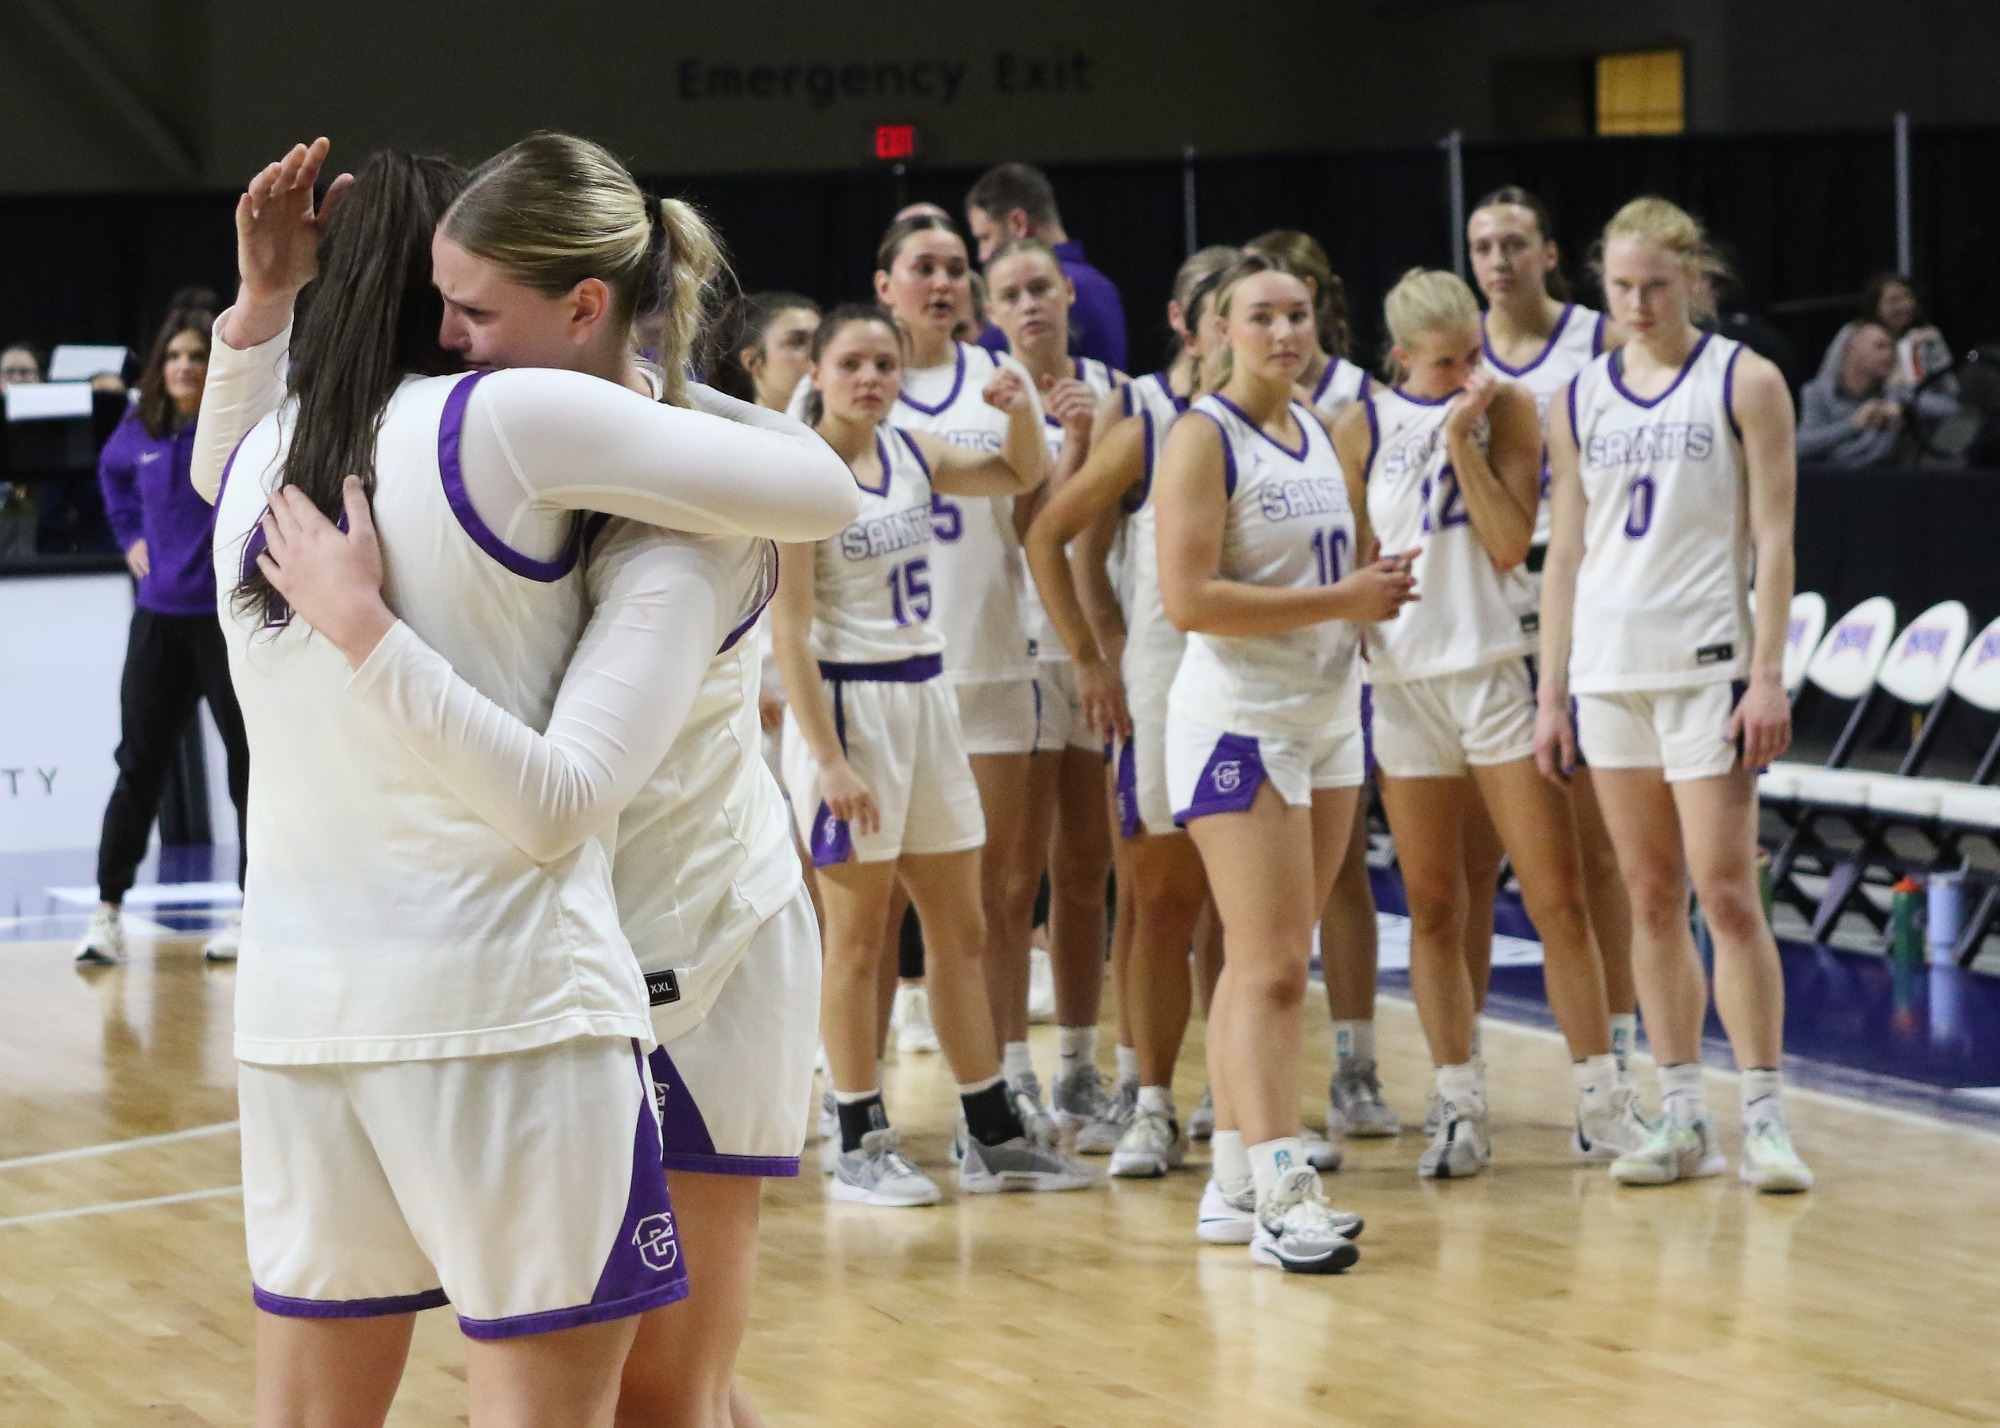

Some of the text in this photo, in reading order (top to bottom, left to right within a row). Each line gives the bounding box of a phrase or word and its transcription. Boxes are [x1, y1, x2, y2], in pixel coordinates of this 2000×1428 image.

[677, 47, 1091, 107] Emergency Exit
[1586, 420, 1714, 471] SAINTS
[1260, 477, 1350, 521] SAINT
[1420, 463, 1473, 535] 12
[1624, 476, 1656, 540] 0
[840, 503, 932, 561] SAINT
[1311, 525, 1348, 587] 10
[887, 555, 932, 627] 15
[650, 982, 673, 994] XXL
